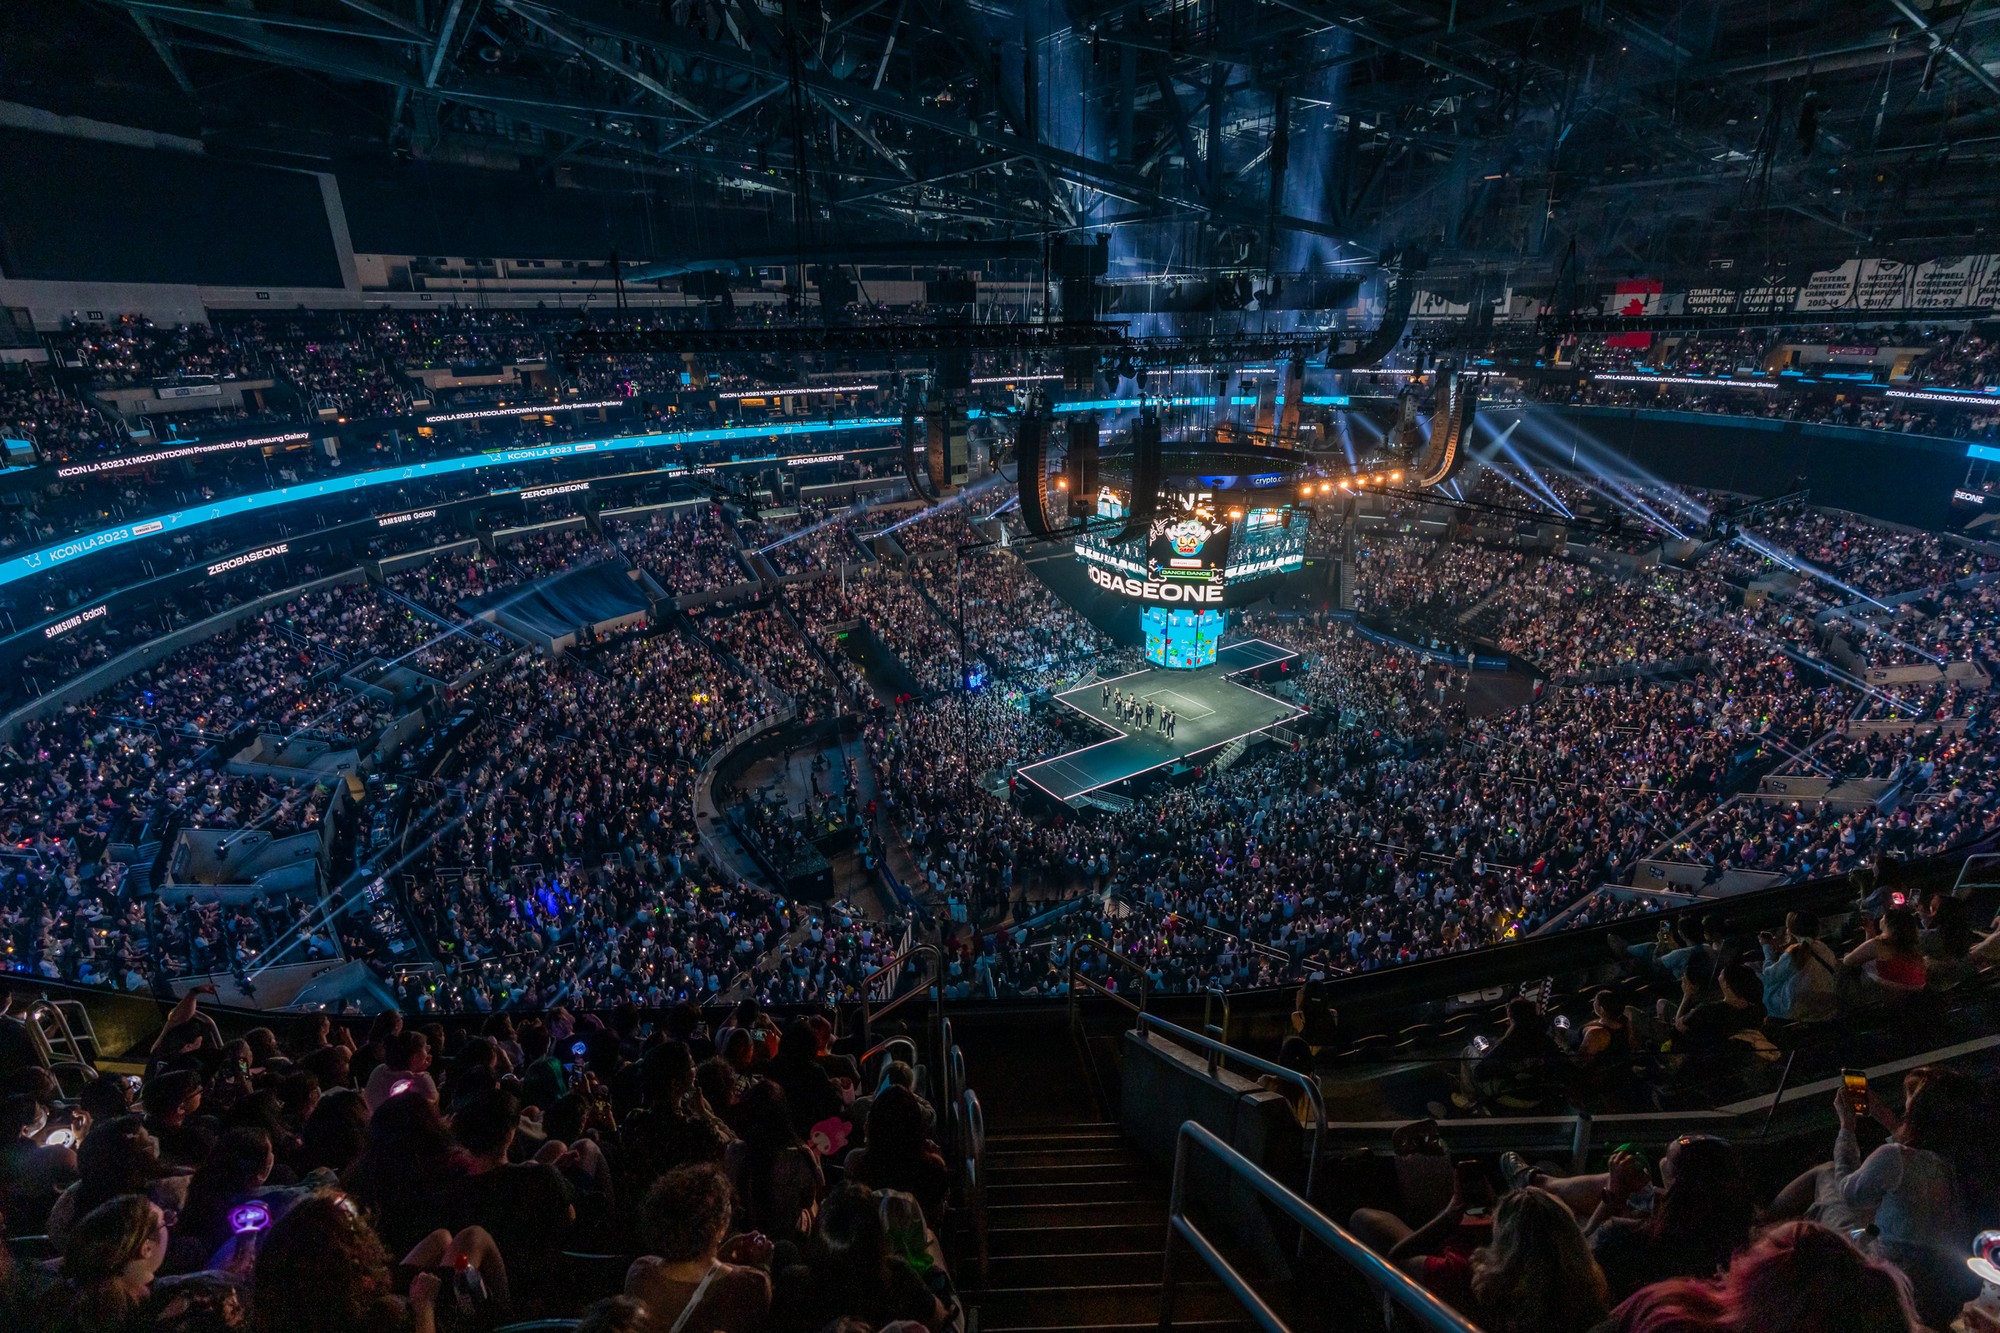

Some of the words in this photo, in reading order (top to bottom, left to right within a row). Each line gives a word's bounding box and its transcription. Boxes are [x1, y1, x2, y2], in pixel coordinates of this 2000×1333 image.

[765, 388, 806, 396] MCOUNTDOWN
[1939, 395, 1995, 405] MCOUNTDOWN
[426, 415, 446, 423] KCON
[447, 413, 457, 421] LA
[456, 412, 473, 420] 2023
[479, 407, 532, 417] MCOUNTDOWN
[532, 404, 564, 412] Presented
[572, 401, 601, 409] Samsung
[58, 465, 87, 478] KCON
[88, 463, 101, 473] LA
[101, 459, 125, 470] 2023
[124, 457, 133, 466] X
[132, 447, 194, 464] MCOUNTDOWN
[194, 440, 236, 454] Presented
[236, 438, 247, 449] by
[247, 435, 285, 446] Samsung
[284, 432, 310, 441] Galaxy
[507, 450, 535, 460] KCON
[536, 448, 550, 457] LA
[549, 446, 573, 455] 2023
[787, 454, 844, 466] ZEROBASEONE
[520, 482, 589, 499] ZEROBASEONE
[379, 514, 411, 527] SAMSUNG
[413, 509, 436, 519] Galaxy
[1165, 520, 1212, 542] KCON
[49, 543, 82, 562] KCON
[82, 538, 98, 550] LA
[97, 529, 129, 546] 2023
[207, 544, 288, 576] ZEROBASEONE
[45, 615, 82, 638] SAMSUNG
[82, 605, 107, 621] Galaxy
